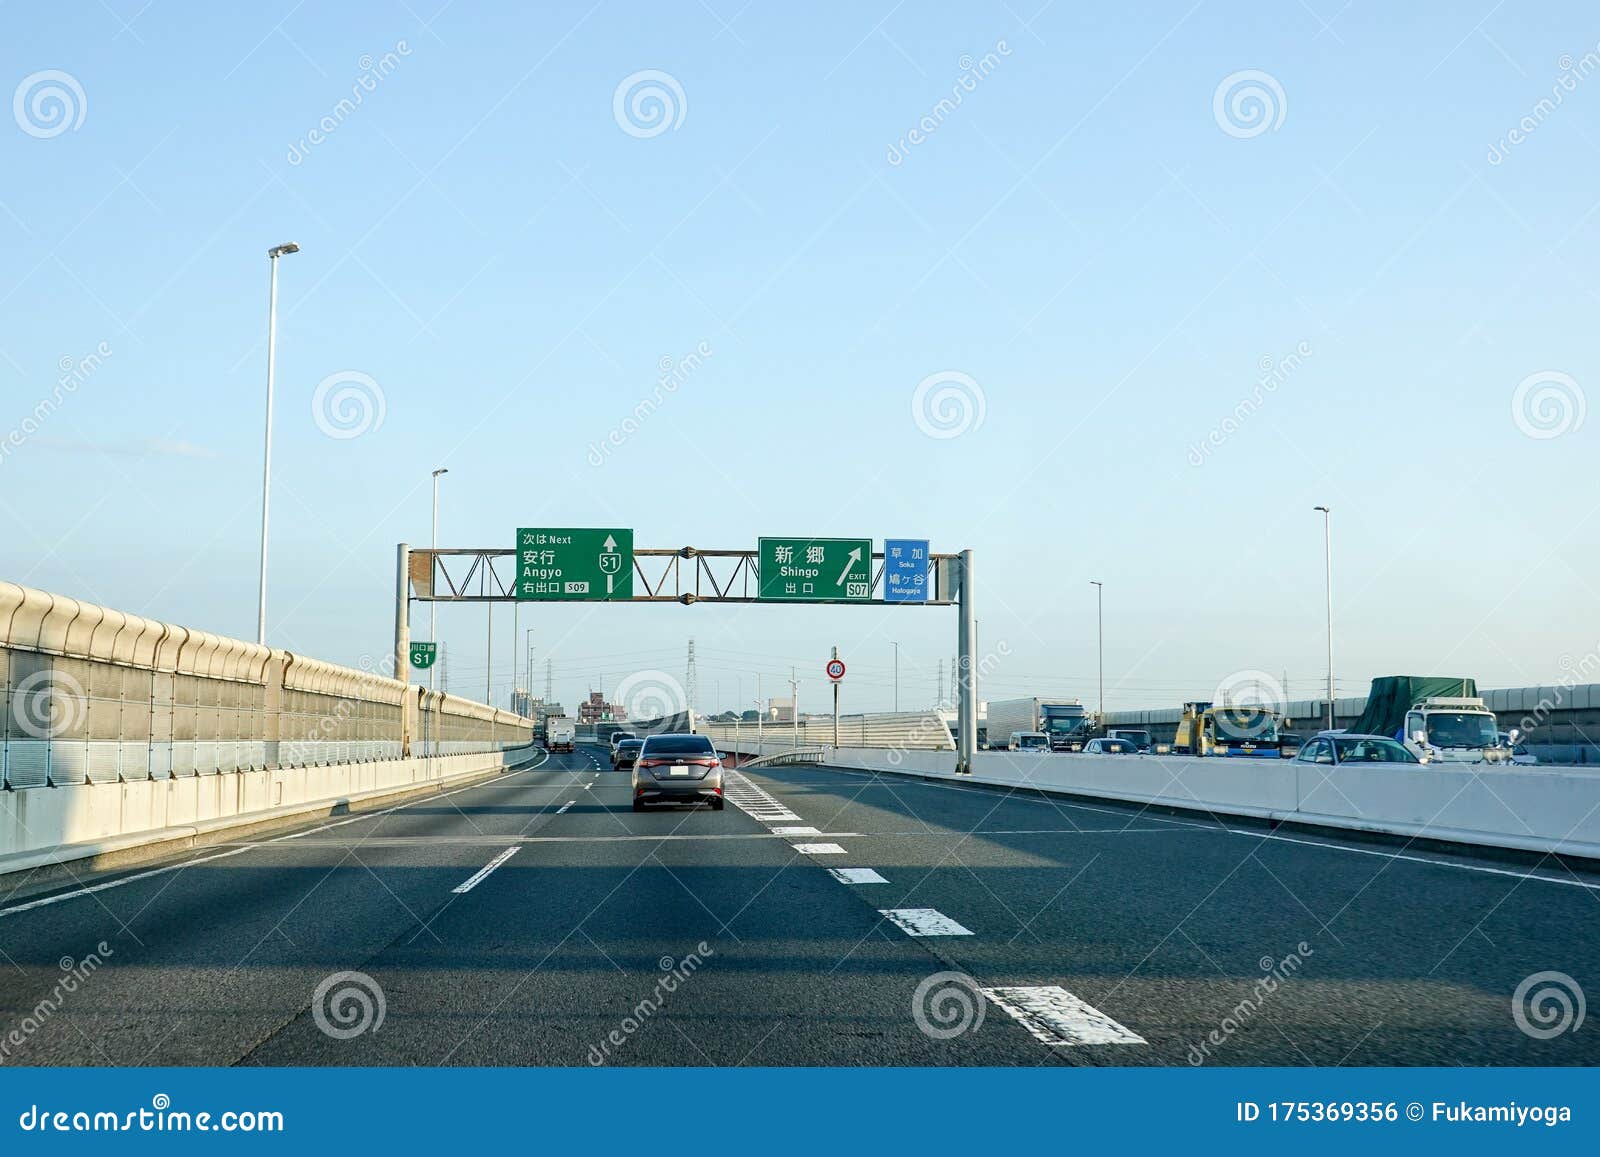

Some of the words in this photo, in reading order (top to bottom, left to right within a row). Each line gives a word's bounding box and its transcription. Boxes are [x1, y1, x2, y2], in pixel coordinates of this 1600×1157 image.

[523, 533, 547, 545] 次は
[549, 535, 571, 544] Next
[523, 550, 555, 565] 安行
[775, 545, 825, 564] 新郷
[602, 556, 616, 569] S1
[523, 566, 562, 580] Angyo
[780, 566, 819, 578] Shingo
[523, 582, 559, 593] 右出口
[568, 583, 585, 592] S09
[785, 582, 813, 594] 出口
[848, 583, 867, 596] S07
[414, 653, 429, 664] S1
[830, 664, 841, 674] 40
